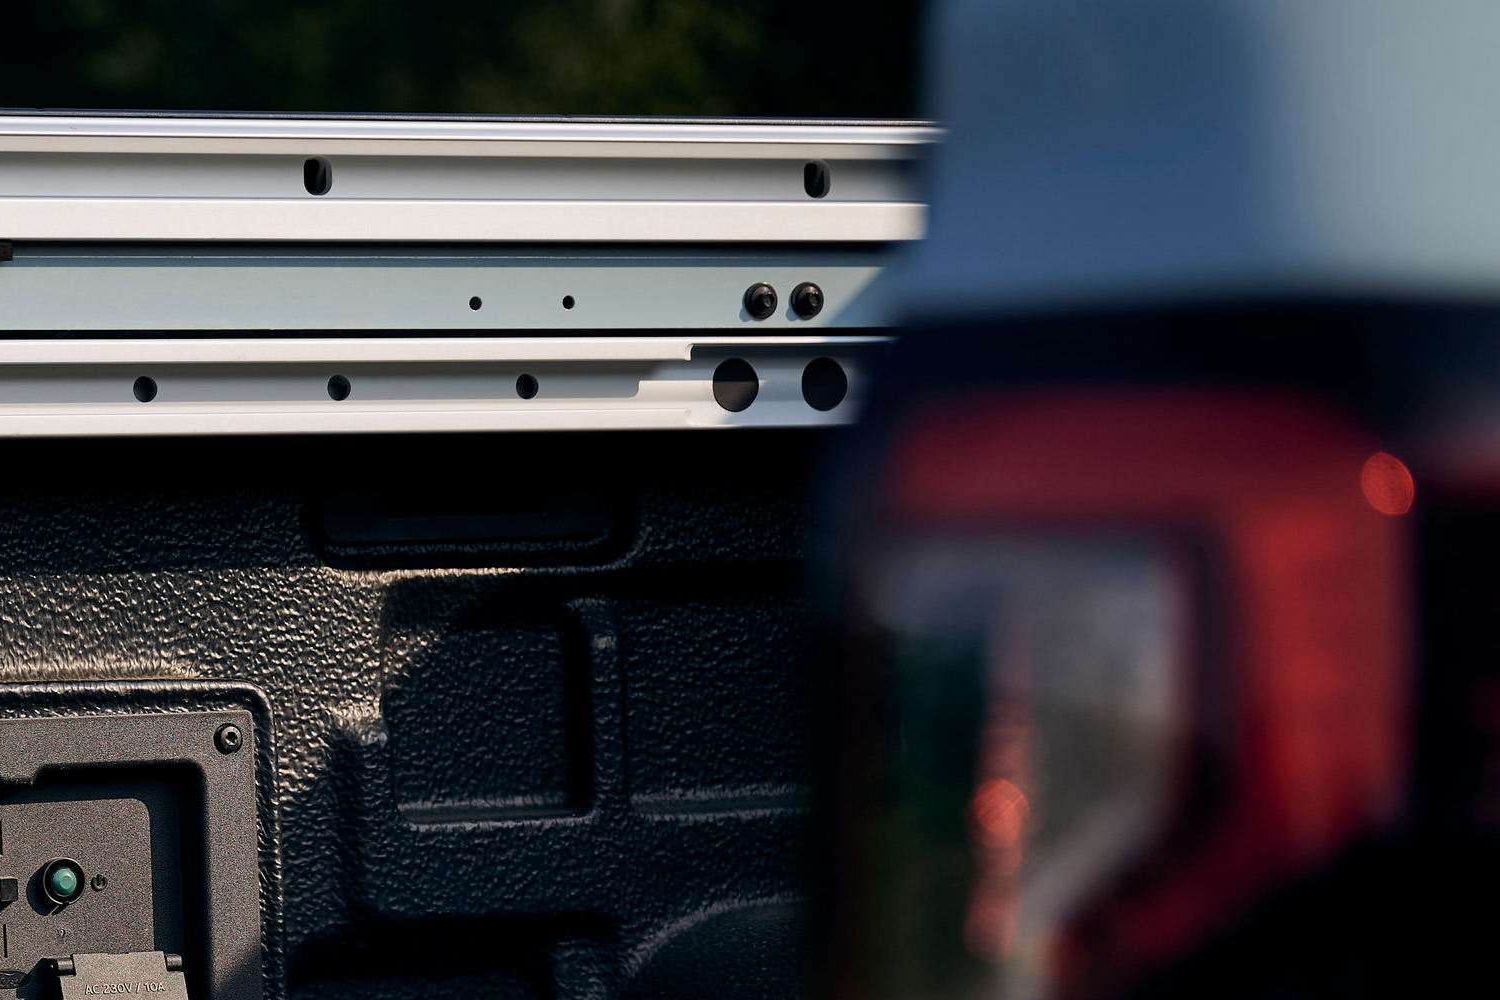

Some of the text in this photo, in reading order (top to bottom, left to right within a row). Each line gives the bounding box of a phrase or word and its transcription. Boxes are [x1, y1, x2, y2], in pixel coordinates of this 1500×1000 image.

[85, 984, 100, 995] AC
[102, 983, 132, 994] 230V
[143, 981, 166, 992] 10A
